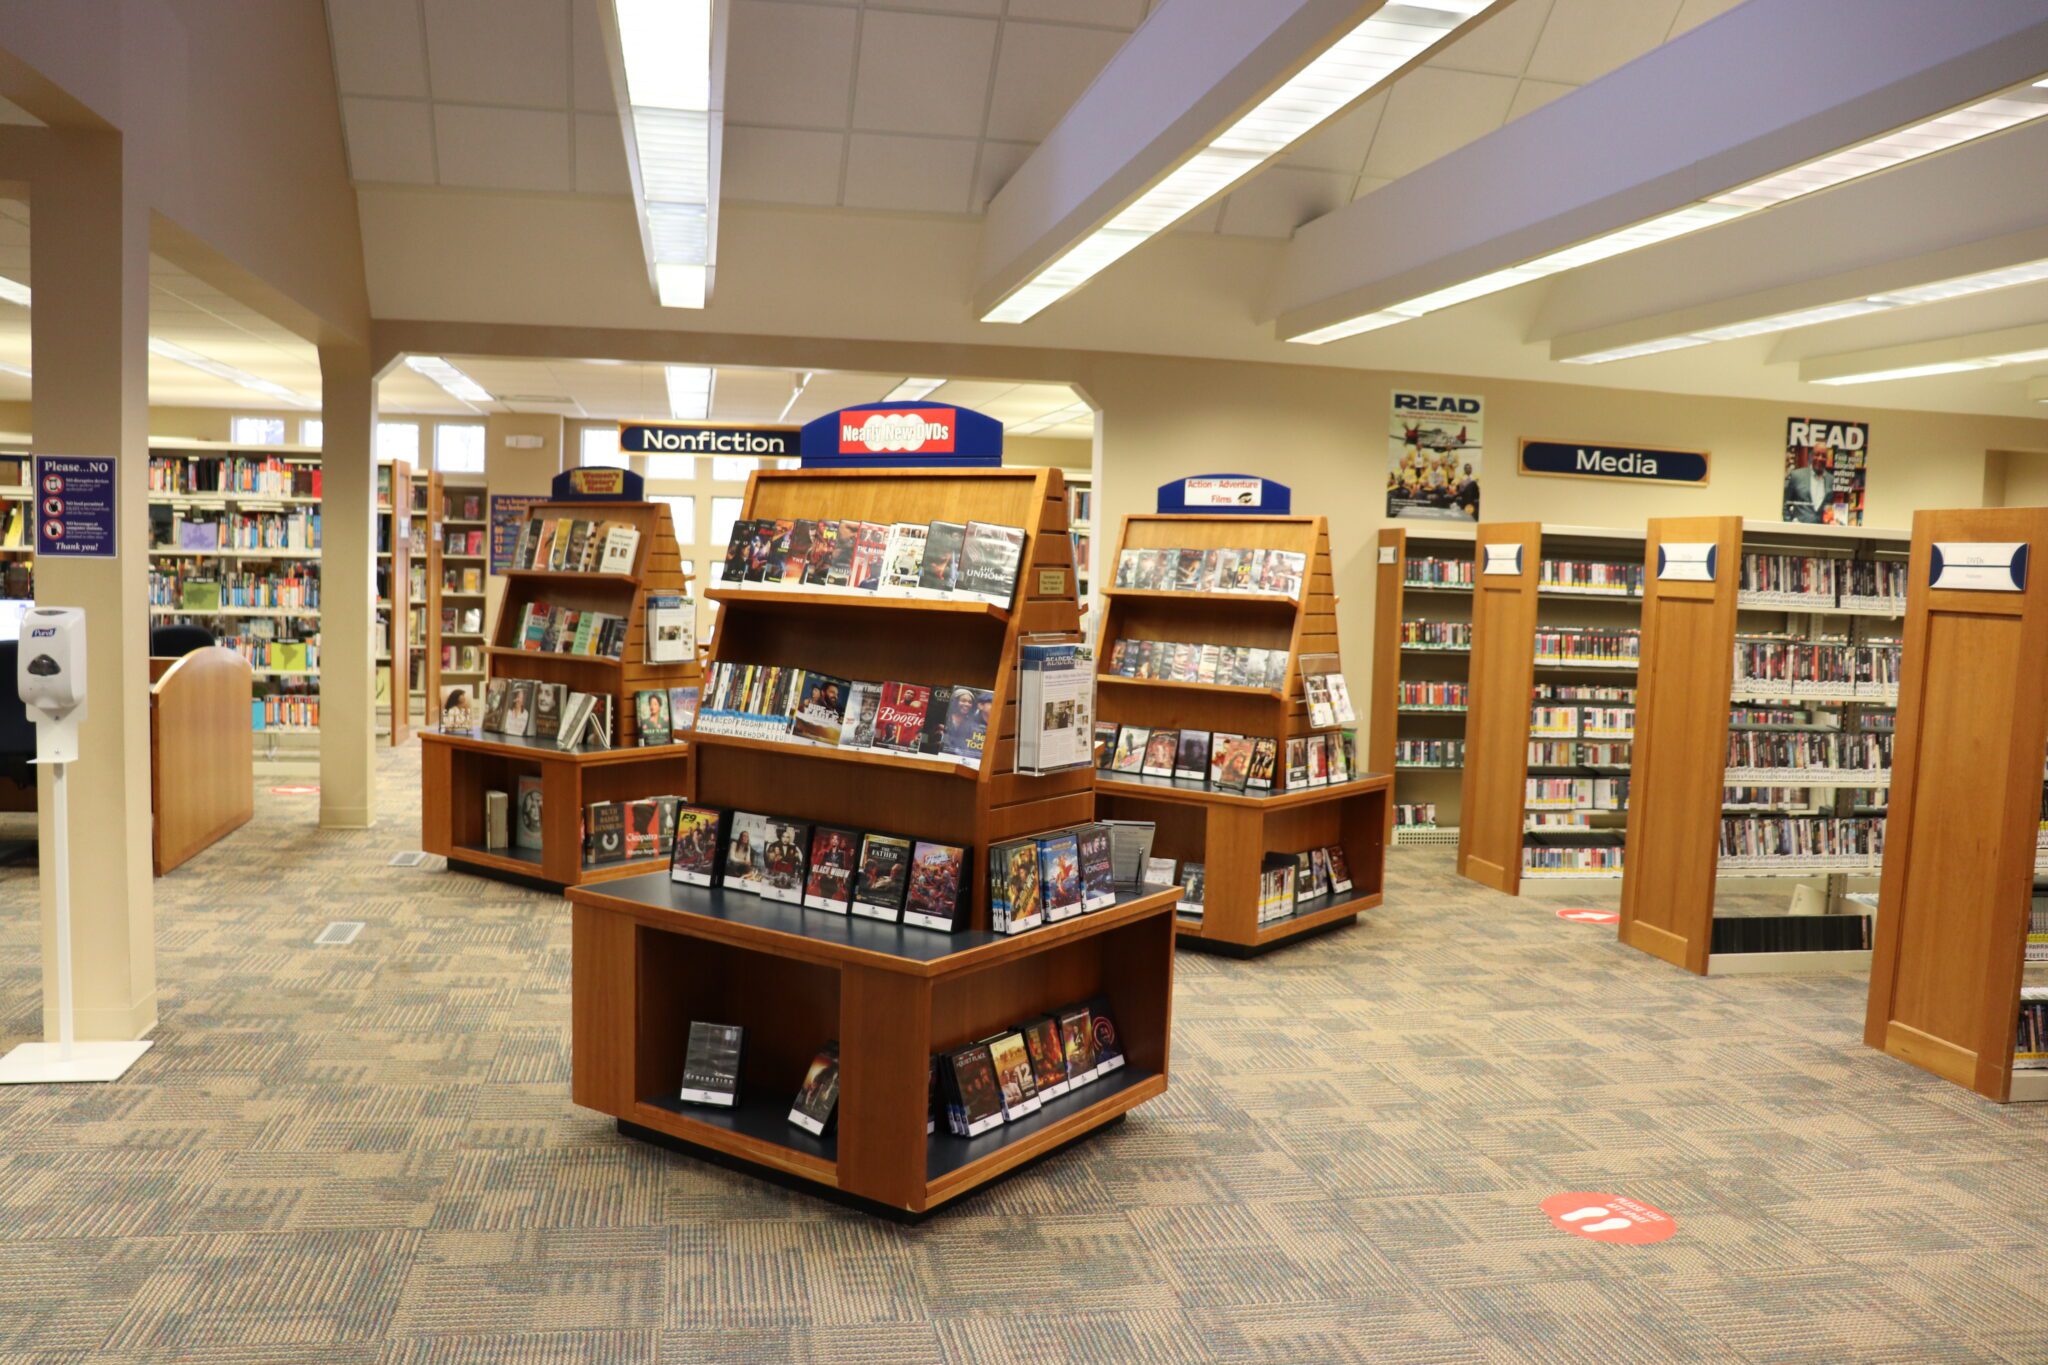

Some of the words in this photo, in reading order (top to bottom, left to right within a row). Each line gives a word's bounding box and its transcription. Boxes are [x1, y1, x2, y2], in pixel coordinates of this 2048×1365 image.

[1394, 394, 1480, 414] READ
[842, 424, 882, 442] Nearly
[886, 423, 913, 441] New
[916, 422, 949, 440] DVDs
[1790, 422, 1864, 450] READ
[643, 429, 785, 453] Nonfiction
[1576, 449, 1657, 475] Media
[1187, 480, 1212, 488] Action
[1219, 480, 1258, 488] Adventure
[1211, 495, 1232, 503] Films
[55, 542, 80, 550] Thank
[81, 543, 99, 552] you!
[880, 706, 925, 727] Boogie
[965, 738, 984, 750] Tod
[682, 813, 697, 822] F9
[626, 833, 658, 843] Cleopatra
[871, 849, 898, 860] FATHER
[812, 864, 832, 875] BLACK
[1014, 1062, 1032, 1084] 12
